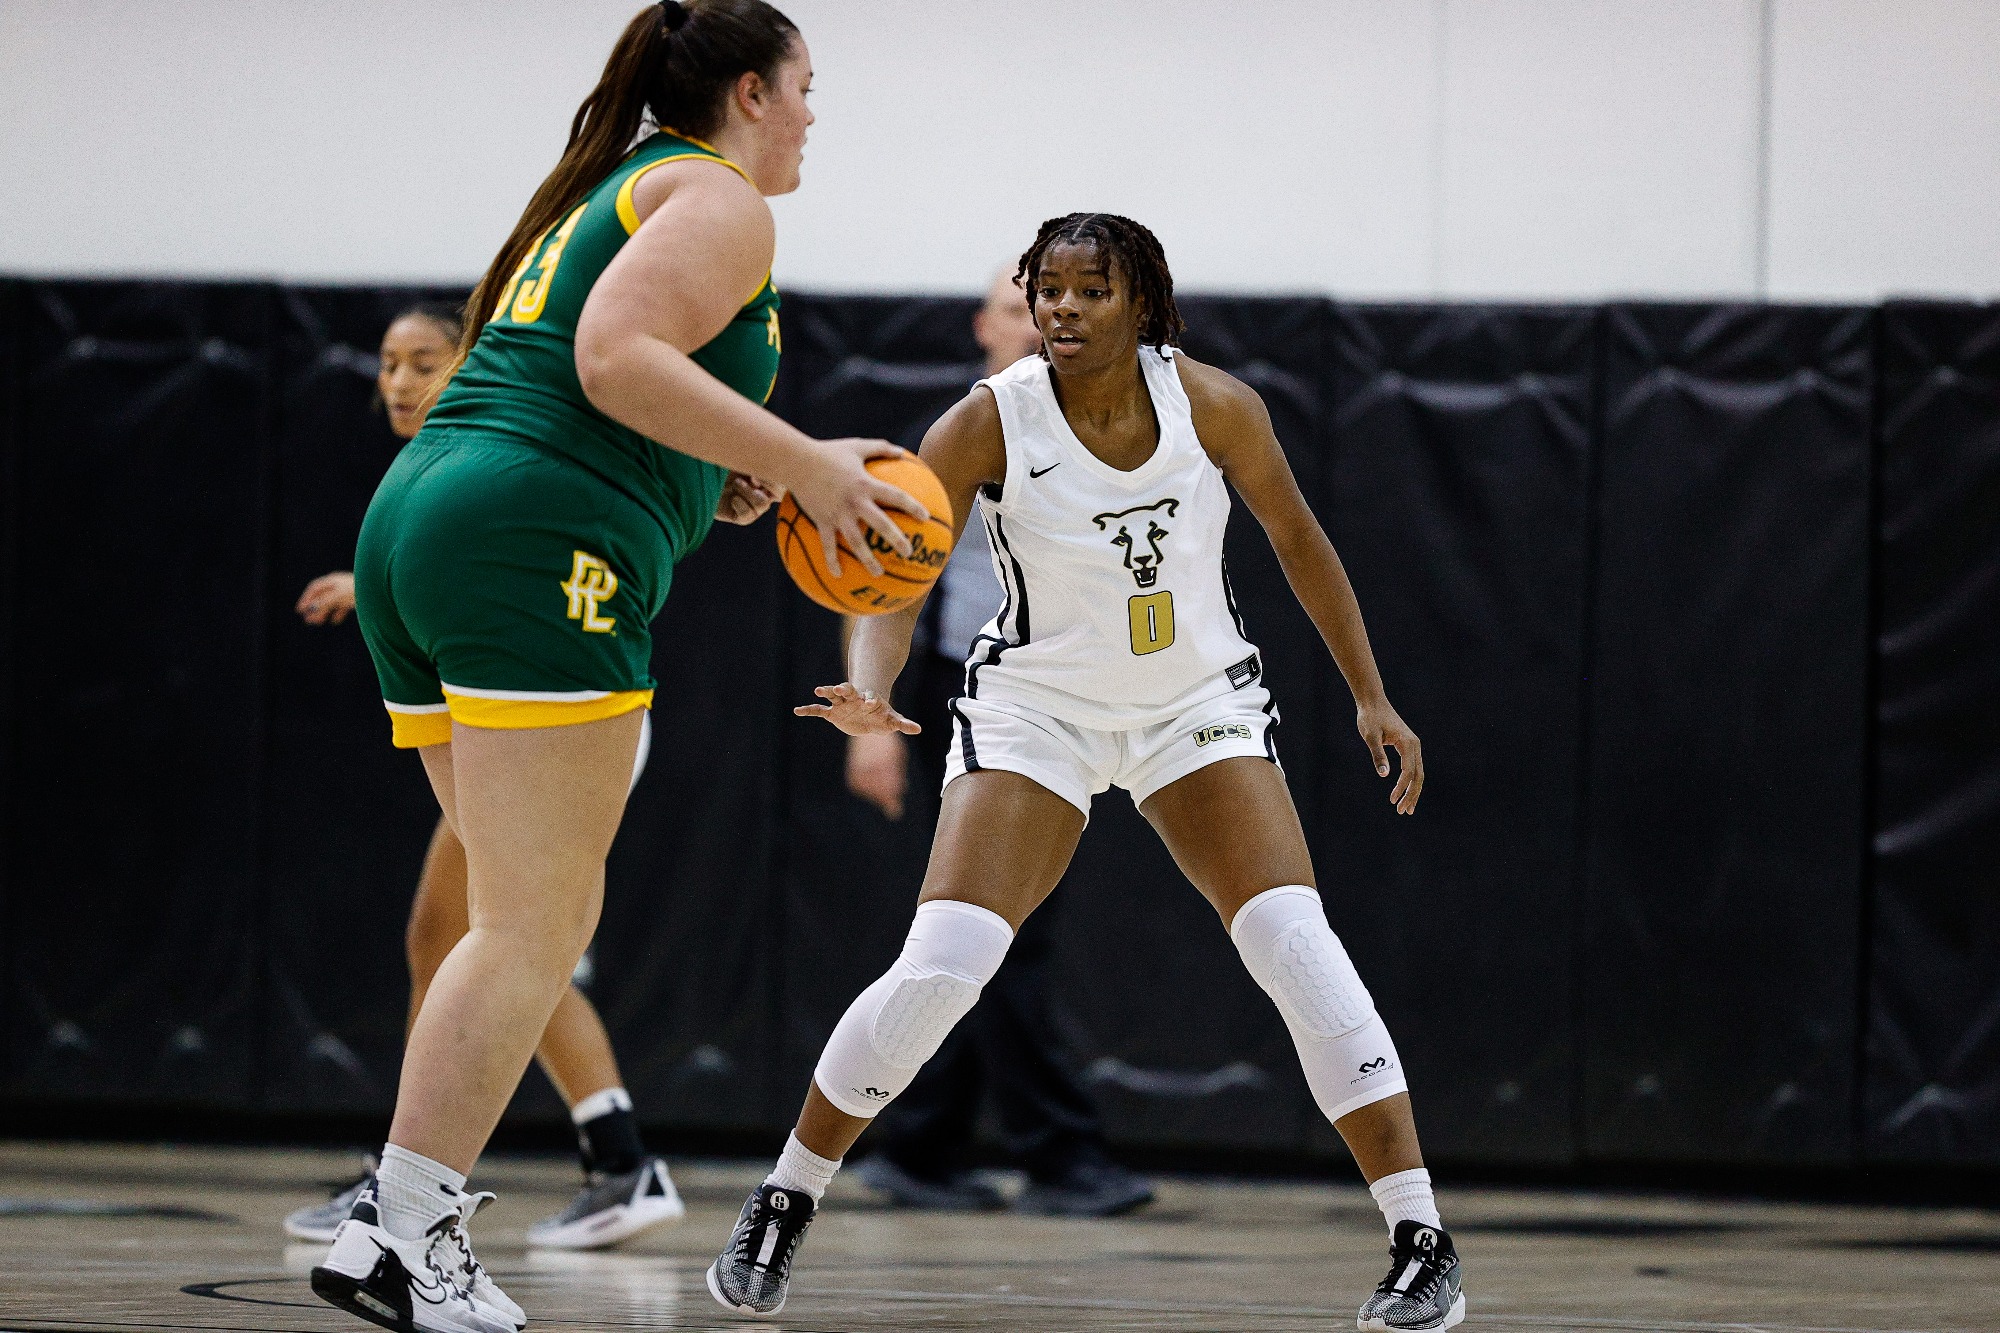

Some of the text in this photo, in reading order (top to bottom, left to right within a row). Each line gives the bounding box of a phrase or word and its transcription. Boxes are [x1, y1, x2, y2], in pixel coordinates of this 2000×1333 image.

[865, 527, 946, 567] Wlson
[1128, 590, 1175, 656] 0
[1193, 724, 1251, 747] UCCS
